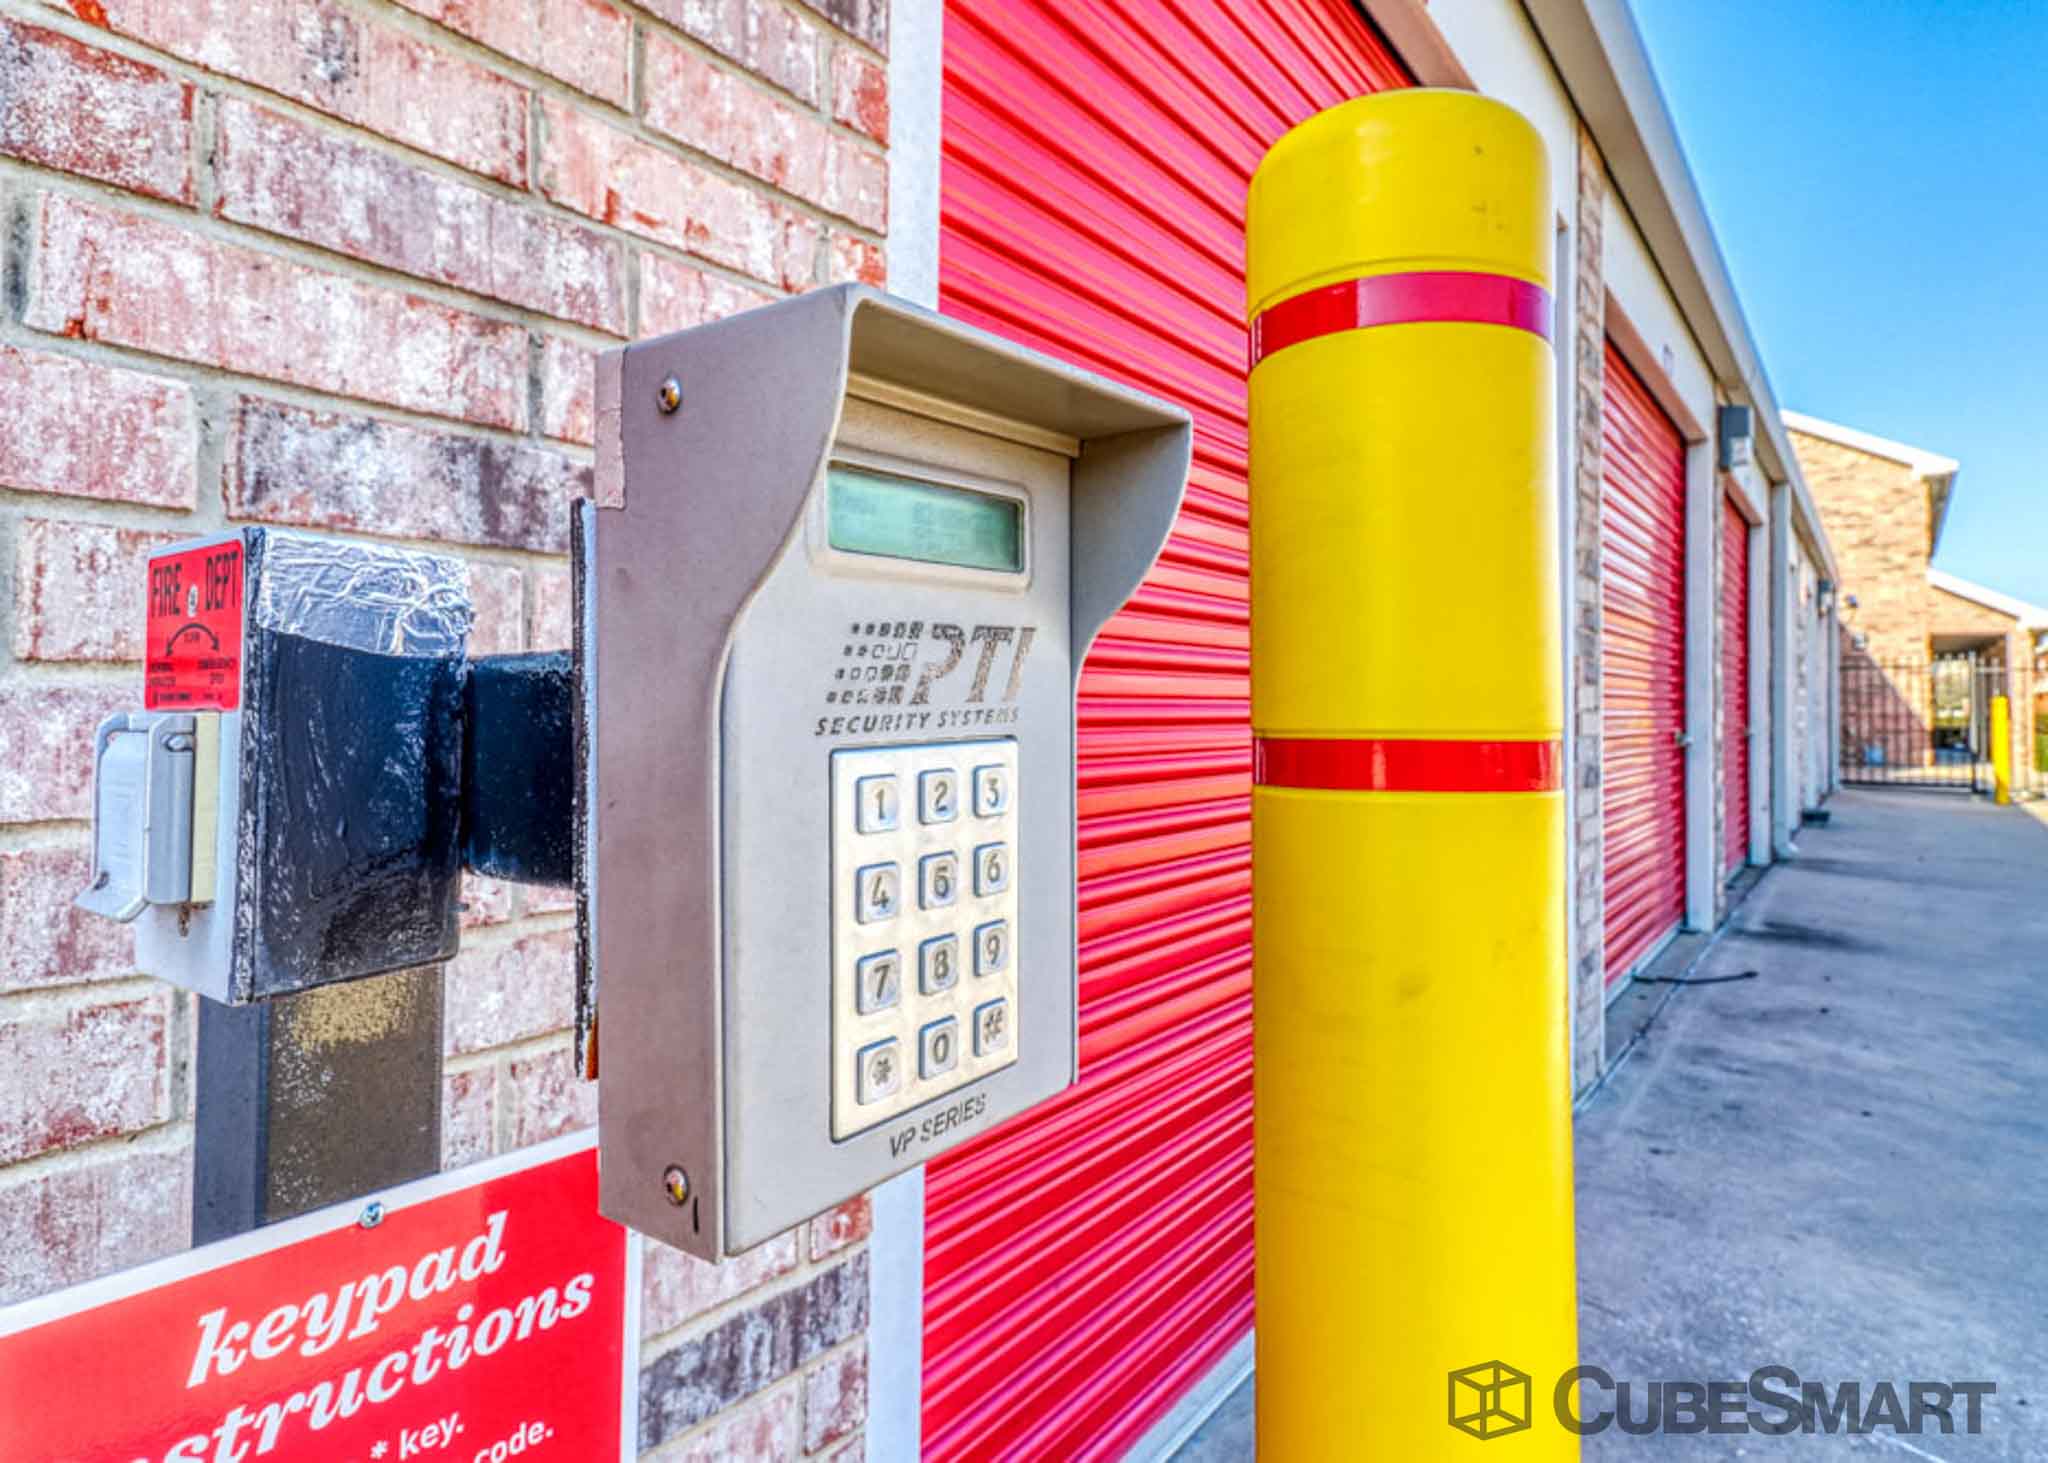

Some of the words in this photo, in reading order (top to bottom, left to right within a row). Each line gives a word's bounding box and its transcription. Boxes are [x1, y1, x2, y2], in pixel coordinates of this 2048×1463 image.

[152, 562, 182, 618] FIRE
[205, 551, 239, 611] DEPT
[814, 711, 930, 736] SECURITY
[937, 706, 1018, 728] SYSTEMS
[875, 788, 885, 820] 1
[934, 781, 948, 812] 2
[986, 777, 999, 808] 3
[871, 876, 889, 909] 4
[987, 853, 1001, 884] 6
[874, 964, 890, 999] 7
[933, 950, 949, 980] 8
[987, 935, 1000, 965] 9
[933, 1034, 949, 1065] 0
[889, 1126, 917, 1158] VP
[920, 1092, 987, 1142] SERIES
[186, 1211, 507, 1388] keypad
[130, 1273, 593, 1463] structions
[399, 1412, 464, 1460] key.
